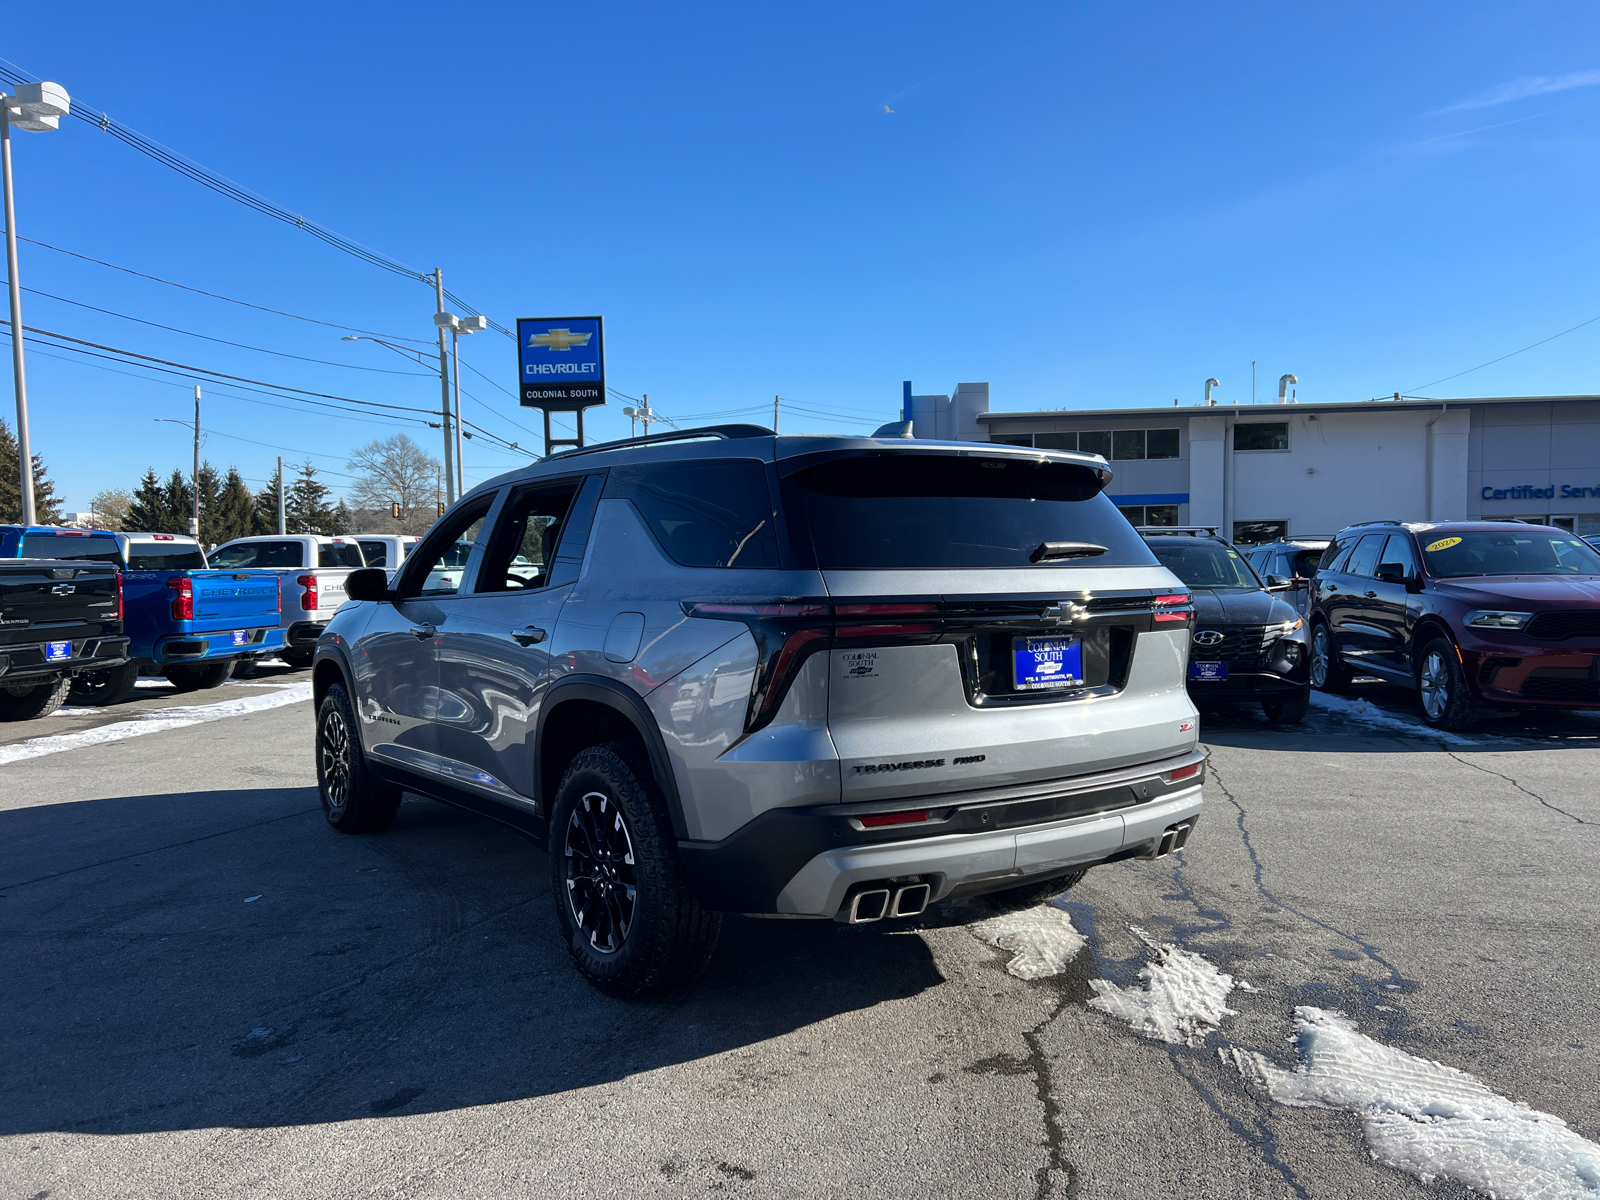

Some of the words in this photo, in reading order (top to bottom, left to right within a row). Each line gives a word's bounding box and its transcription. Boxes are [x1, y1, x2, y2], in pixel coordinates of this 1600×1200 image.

[526, 363, 596, 374] CHEVROLET
[526, 390, 567, 398] COLONIAL
[570, 389, 598, 397] SOUTH
[1481, 484, 1555, 500] Certified
[1432, 538, 1456, 550] 2024
[201, 587, 276, 597] CHEVROLET
[1027, 641, 1069, 653] COLONIAL
[843, 652, 879, 661] COLONIAL
[1034, 651, 1063, 662] SOUTH
[368, 714, 401, 726] TRAVERSE
[853, 758, 946, 773] TRAVERSE
[953, 755, 986, 766] AWD
